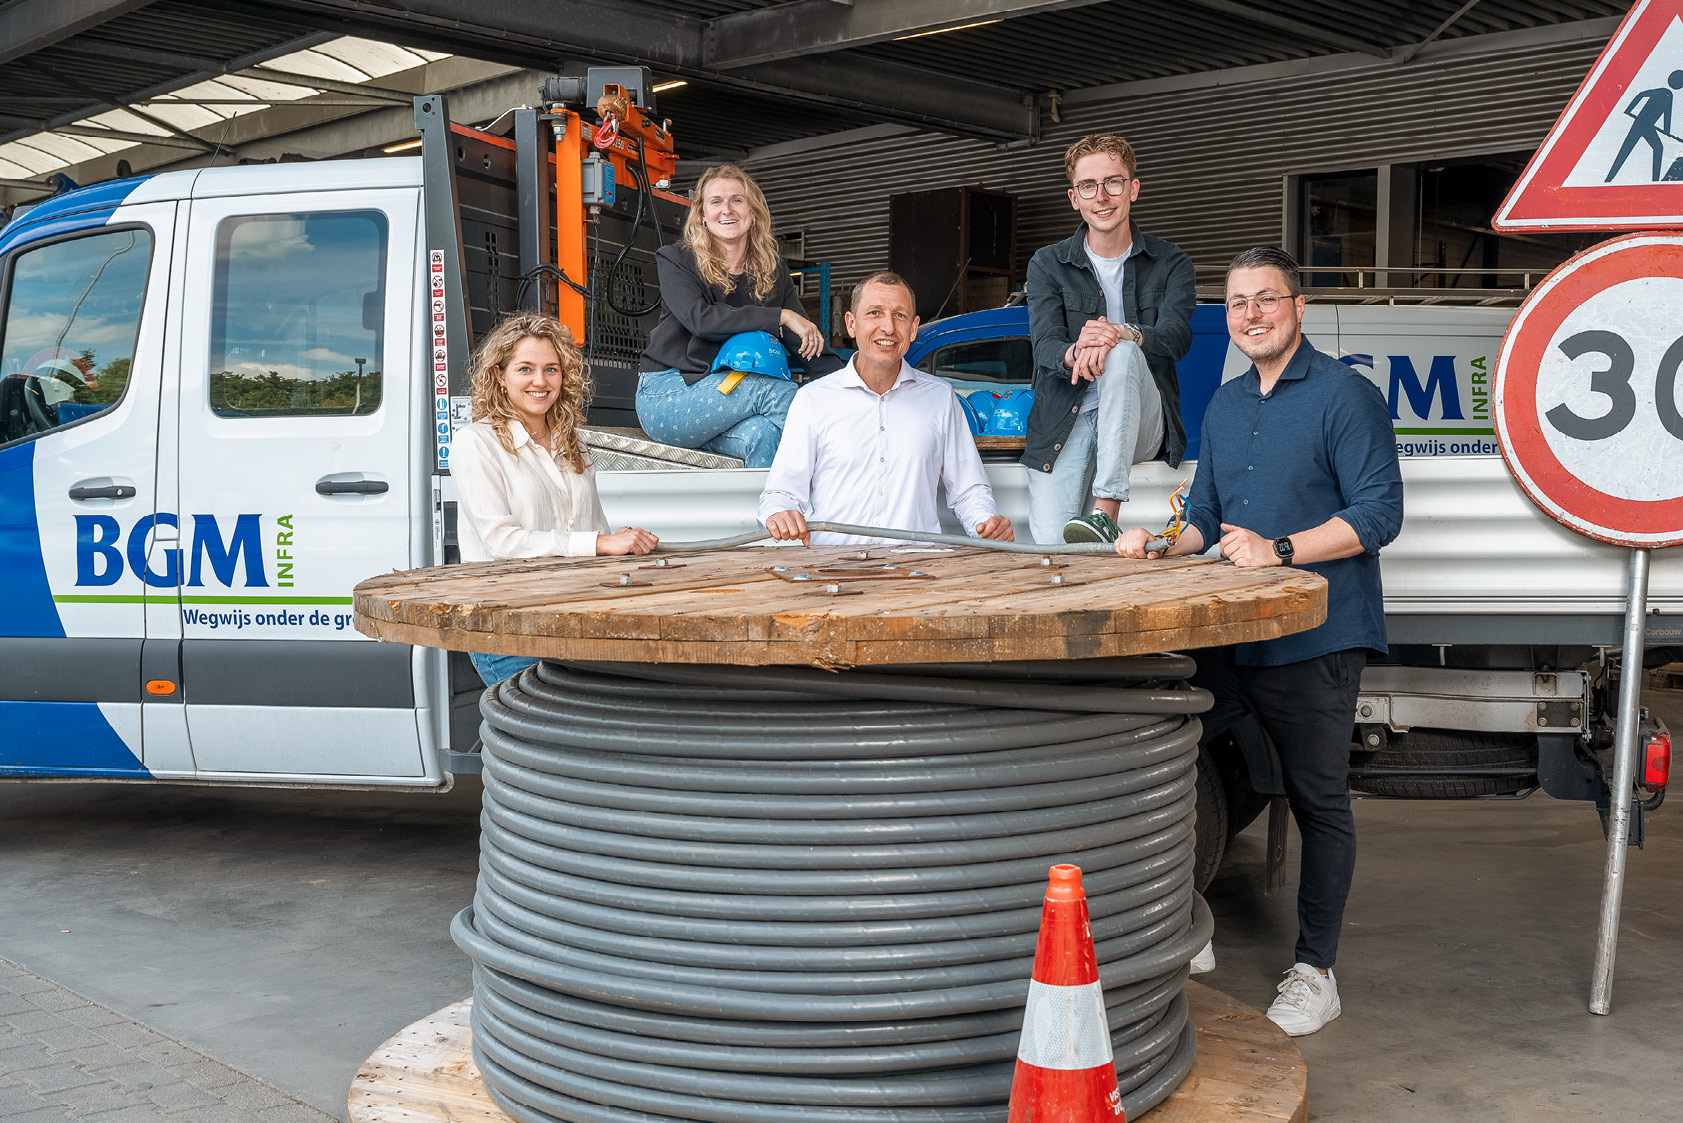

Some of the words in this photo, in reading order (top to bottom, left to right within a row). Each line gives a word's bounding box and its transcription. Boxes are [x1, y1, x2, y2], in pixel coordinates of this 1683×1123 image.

[1471, 356, 1488, 419] INFRA
[1397, 440, 1446, 456] egwijs
[1450, 440, 1498, 454] onder
[73, 513, 270, 588] BGM
[277, 514, 294, 587] INFRA
[183, 609, 251, 629] Wegwijs
[255, 610, 304, 625] onder
[309, 610, 330, 625] de
[334, 614, 354, 630] gr
